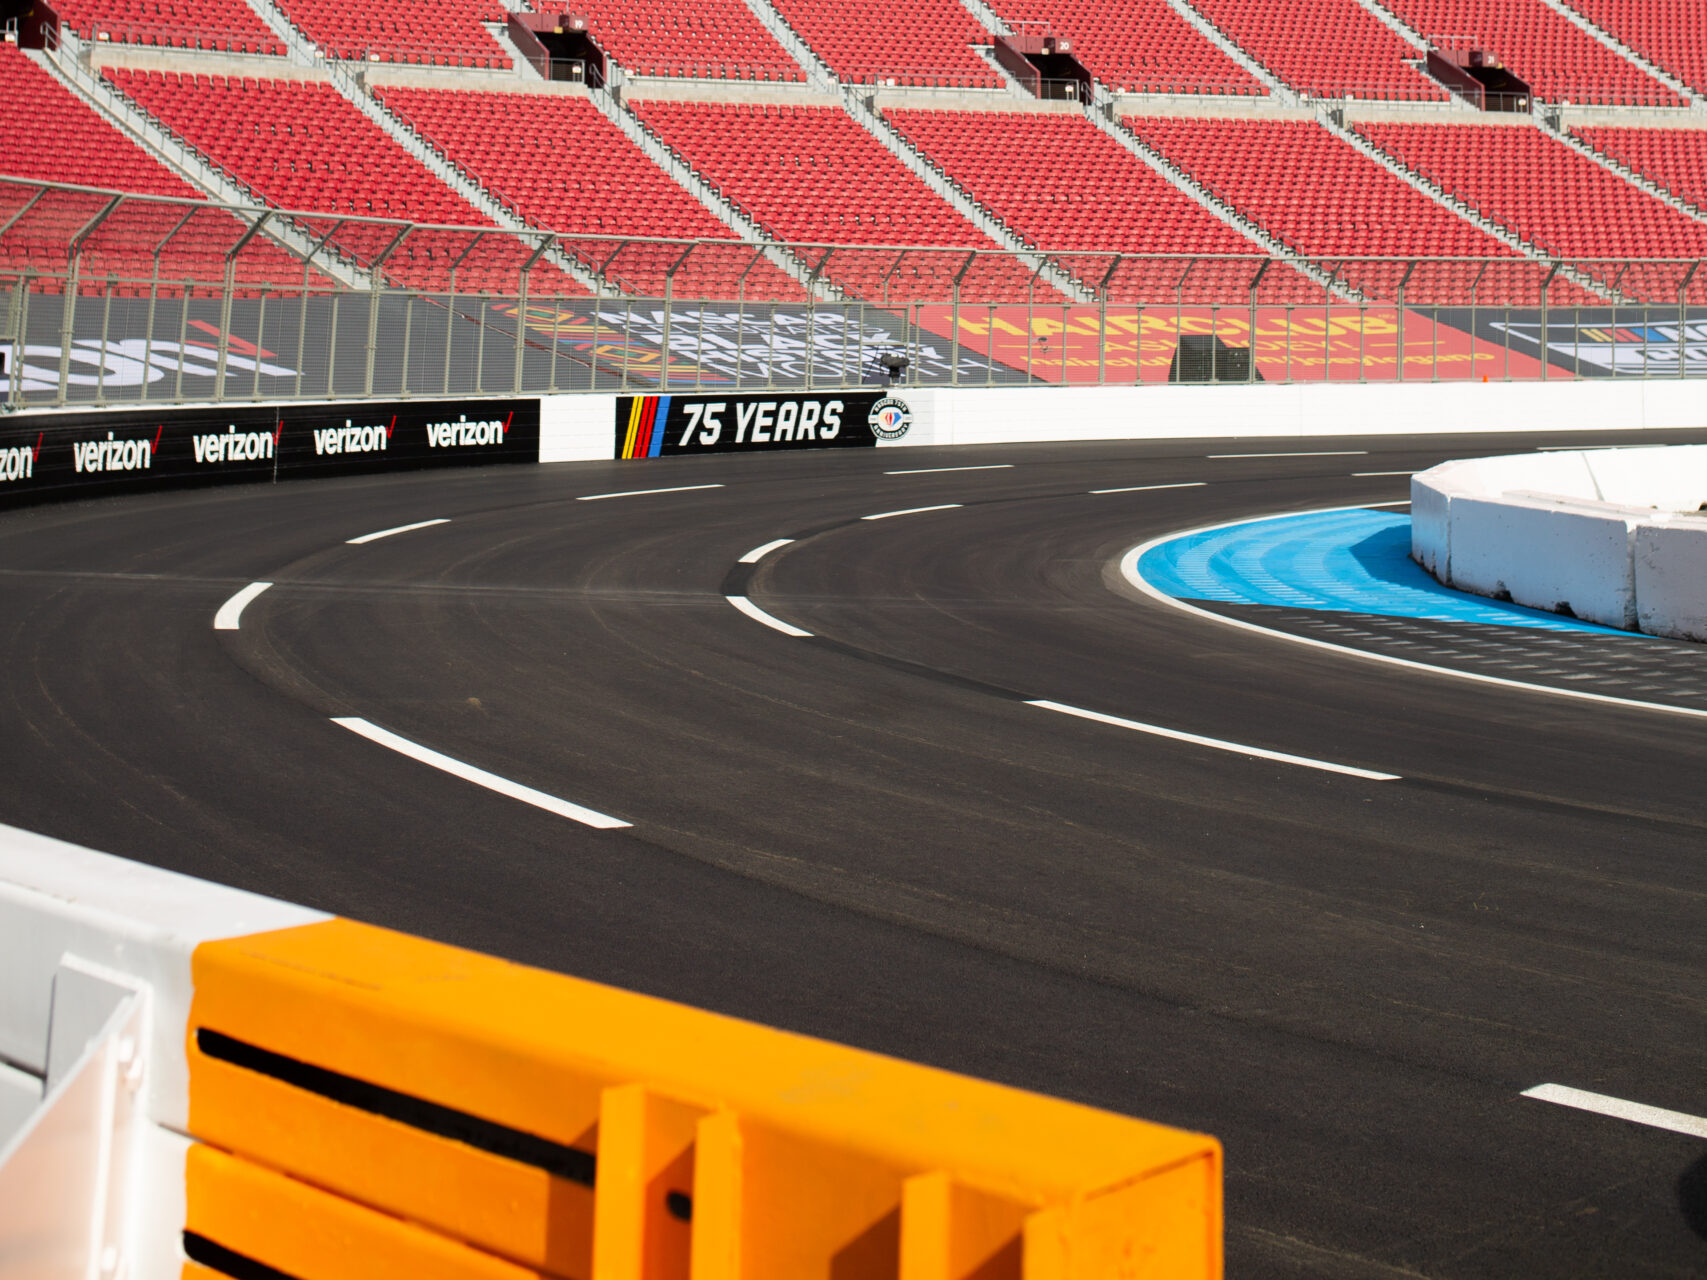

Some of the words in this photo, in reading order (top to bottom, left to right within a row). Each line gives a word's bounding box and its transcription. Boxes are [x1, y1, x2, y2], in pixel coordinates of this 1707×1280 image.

[1060, 41, 1070, 51] 20
[590, 311, 866, 325] NASCAR
[622, 323, 886, 334] CELEBRATES
[944, 315, 1405, 336] HAIRCLUB
[640, 333, 927, 350] BLACK
[314, 419, 387, 455] verizon
[427, 415, 503, 448] verizon
[678, 402, 727, 447] 75
[734, 401, 844, 443] YEARS
[73, 431, 151, 472] verizon
[193, 425, 273, 463] verizon
